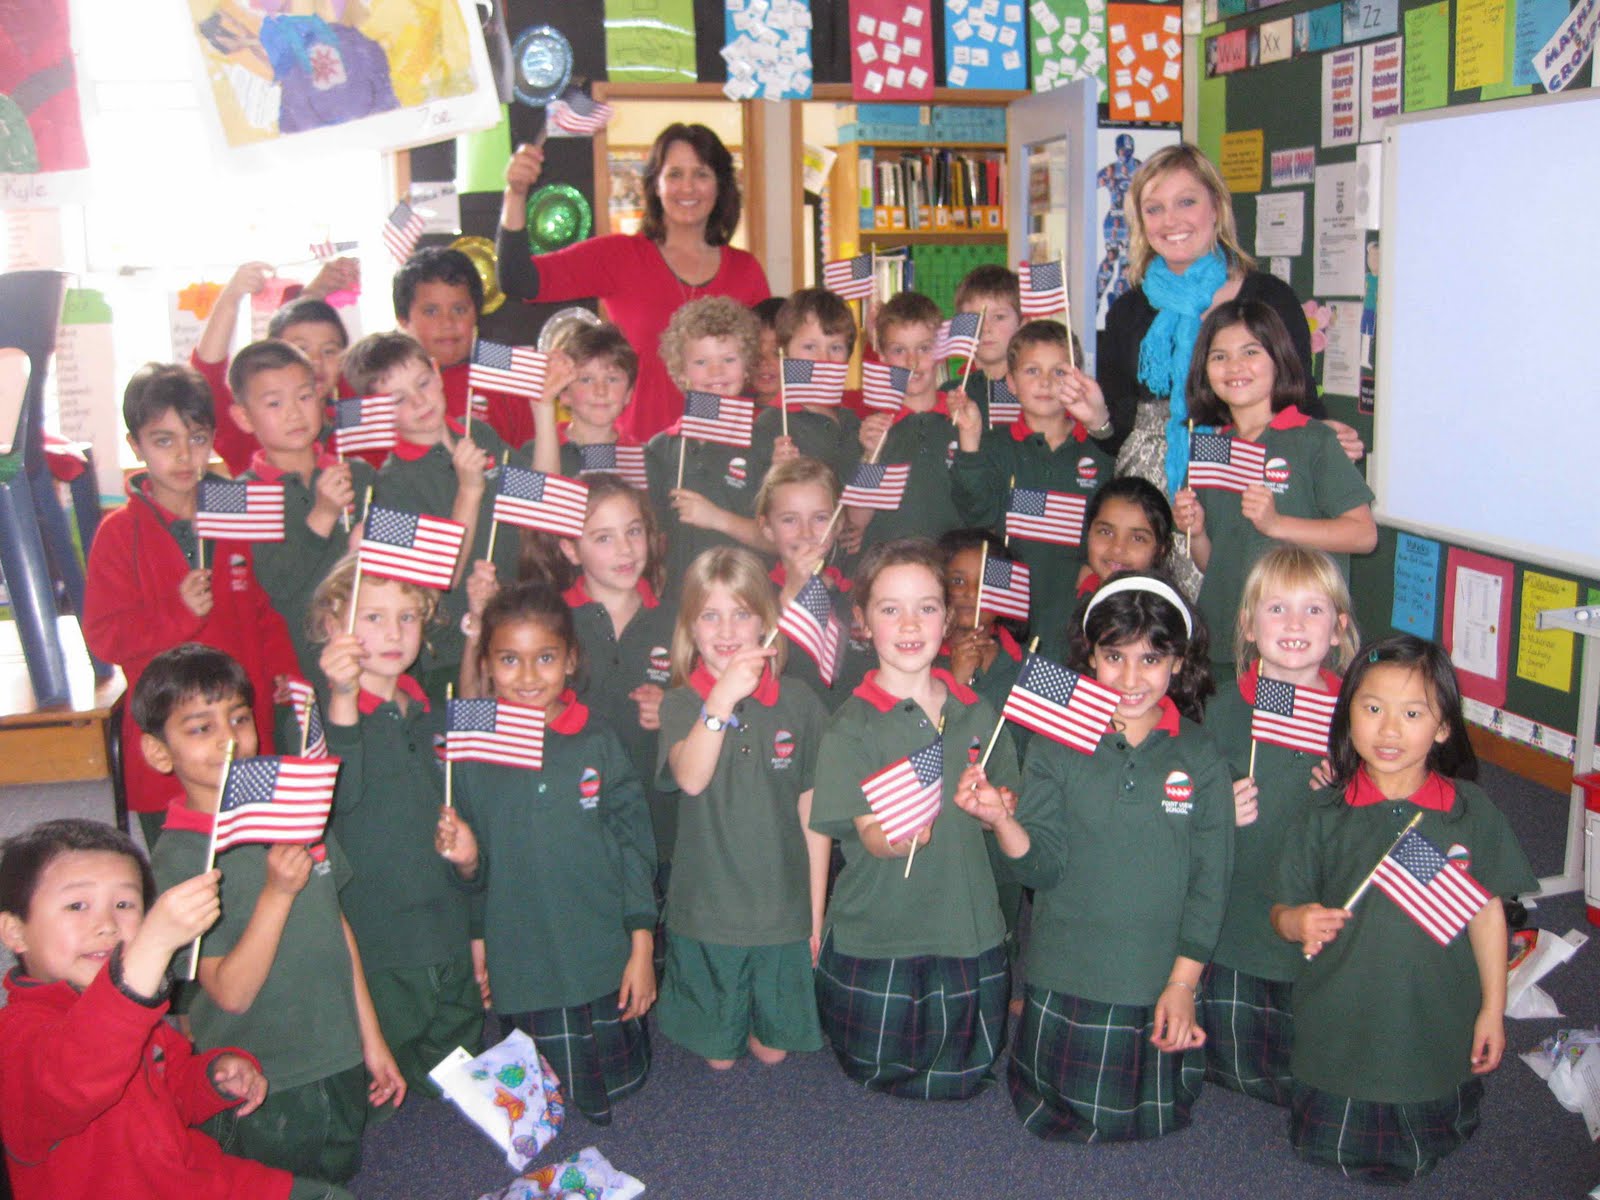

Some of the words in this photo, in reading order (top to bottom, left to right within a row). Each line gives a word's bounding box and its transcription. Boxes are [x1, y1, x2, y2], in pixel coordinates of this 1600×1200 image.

[1362, 5, 1382, 30] Zz
[1311, 20, 1329, 40] Yy
[1263, 33, 1281, 53] Xx
[1220, 45, 1242, 63] Ww
[1332, 76, 1353, 89] March
[1333, 102, 1352, 113] May
[1333, 127, 1352, 138] July
[4, 174, 48, 201] Kyle
